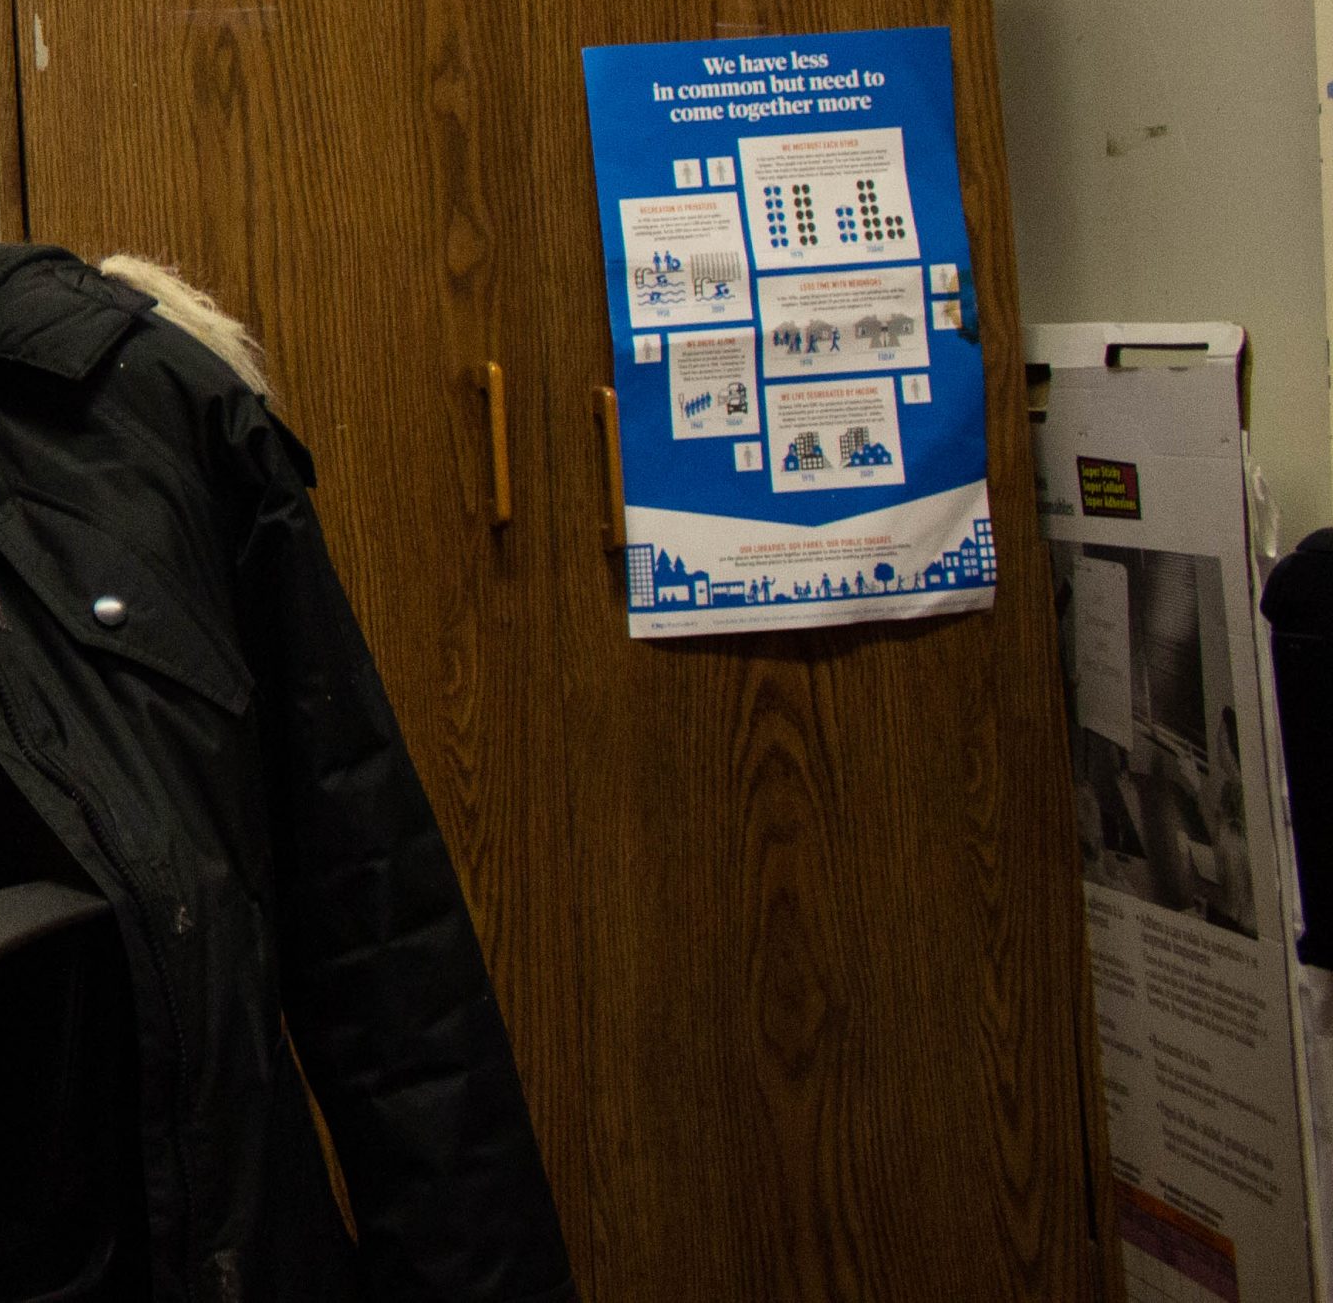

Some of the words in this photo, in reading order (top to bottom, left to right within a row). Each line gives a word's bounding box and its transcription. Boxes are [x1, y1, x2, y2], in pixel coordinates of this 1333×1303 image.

[703, 57, 736, 76] We
[740, 54, 787, 74] have
[790, 51, 829, 70] less
[653, 81, 674, 102] in
[677, 79, 767, 100] common
[769, 74, 806, 94] but
[809, 69, 860, 91] need
[863, 70, 885, 88] to
[670, 103, 724, 123] come
[728, 96, 813, 122] together
[818, 95, 872, 114] more
